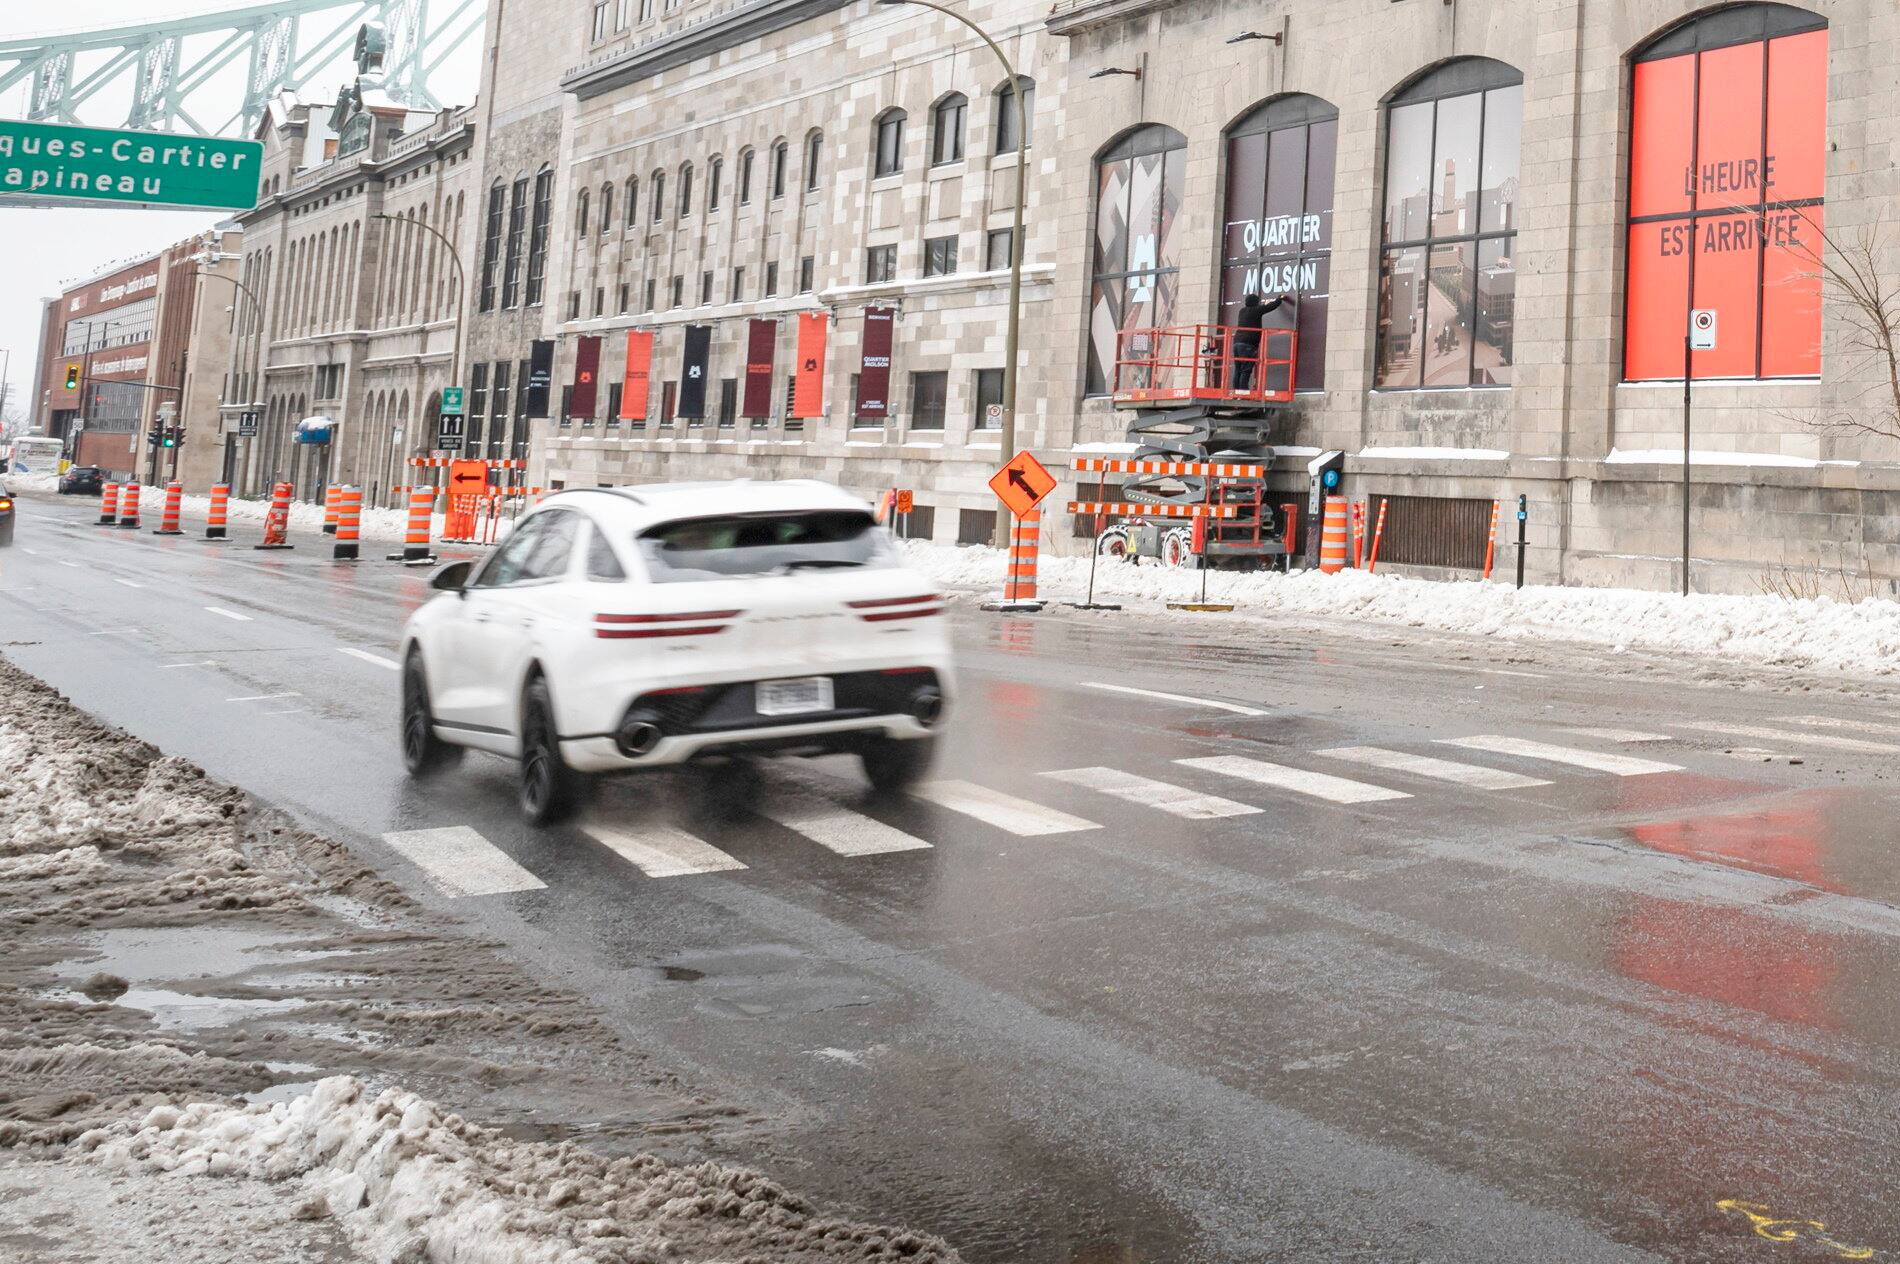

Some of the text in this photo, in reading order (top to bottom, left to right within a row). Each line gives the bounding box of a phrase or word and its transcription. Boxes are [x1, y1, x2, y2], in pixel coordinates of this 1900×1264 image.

[4, 166, 161, 196] apineau
[1685, 156, 1775, 196] L'HEURE
[1243, 214, 1321, 253] QUARTIER
[1660, 208, 1801, 256] EST ARRIVÉE
[1243, 262, 1317, 295] MOLSON
